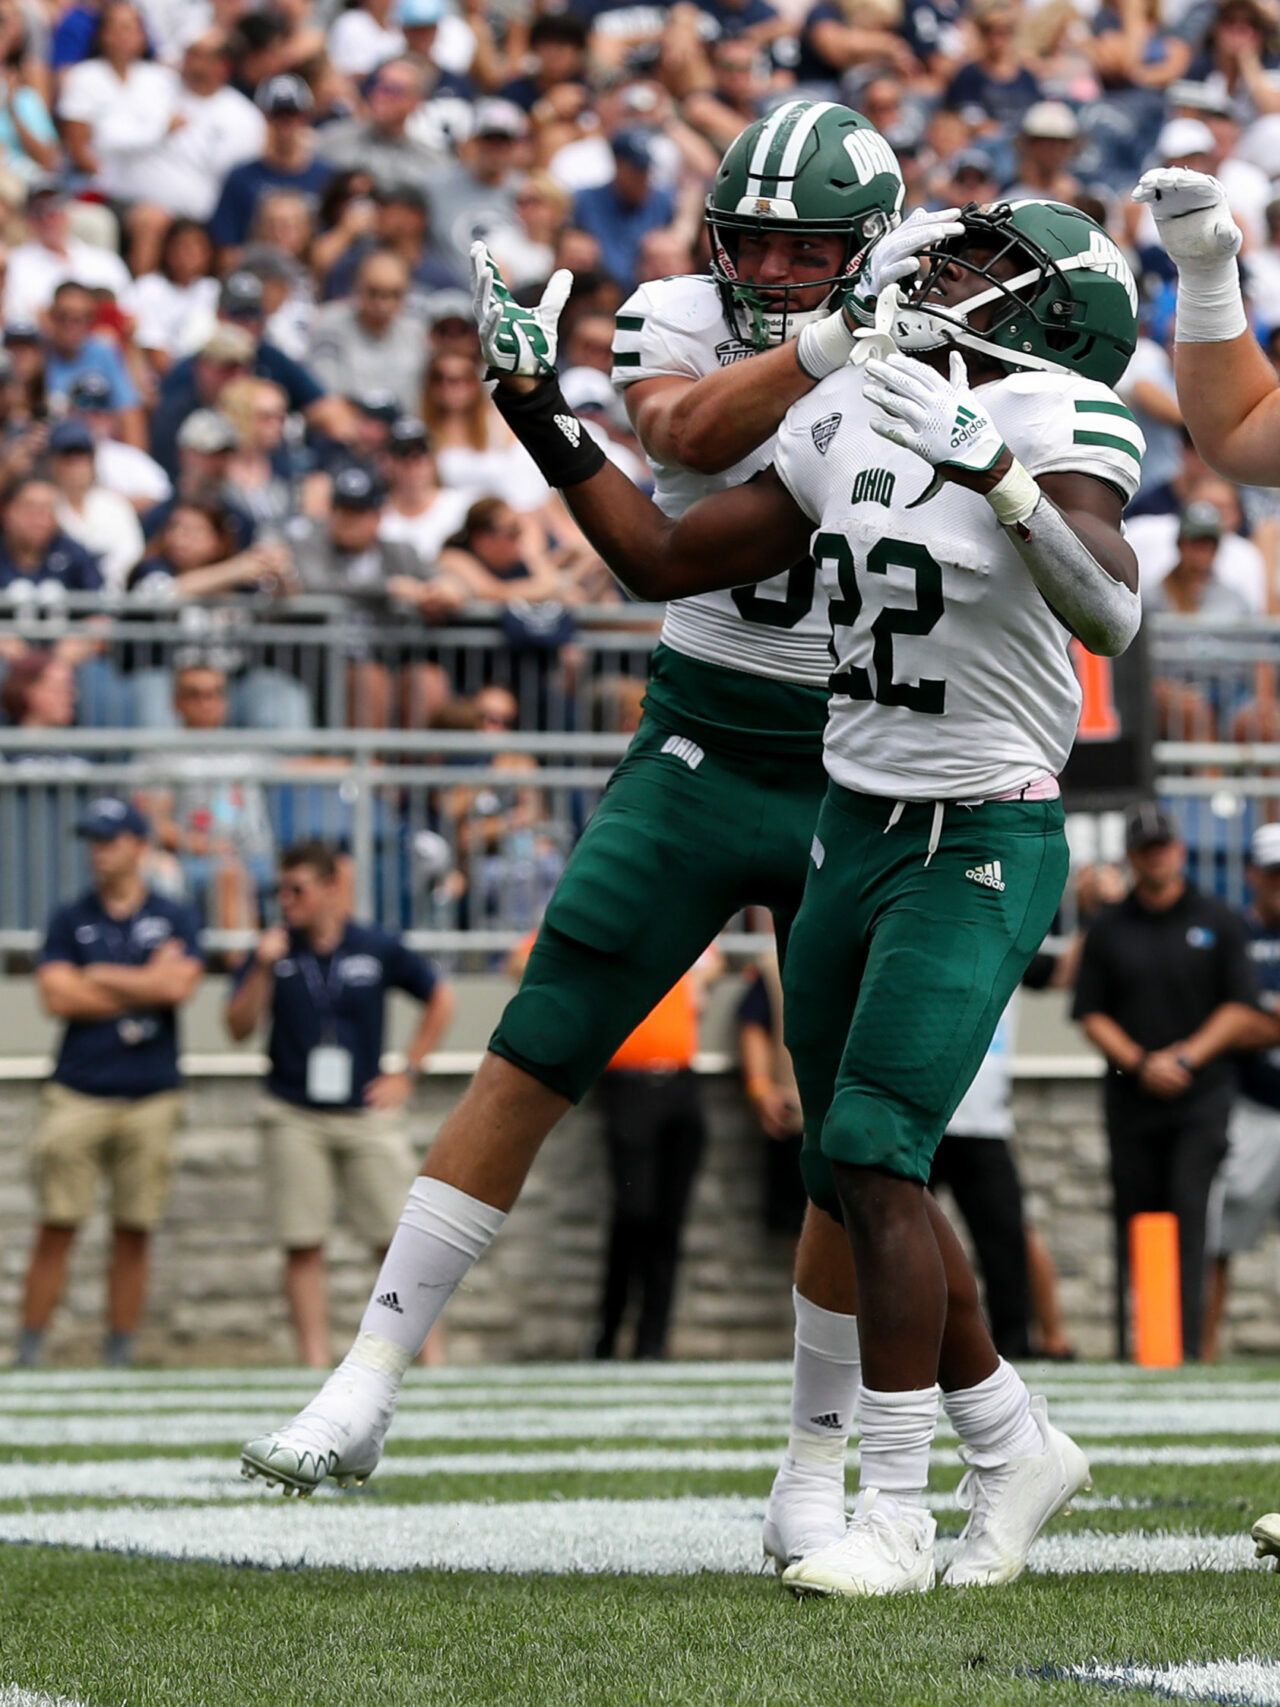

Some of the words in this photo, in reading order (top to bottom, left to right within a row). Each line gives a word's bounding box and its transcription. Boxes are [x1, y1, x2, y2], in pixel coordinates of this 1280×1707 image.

[553, 414, 580, 449] adidas
[950, 416, 988, 449] adidas
[851, 467, 896, 508] OHIO
[812, 532, 946, 715] 22
[660, 735, 705, 770] OHIO
[965, 869, 1006, 892] adidas
